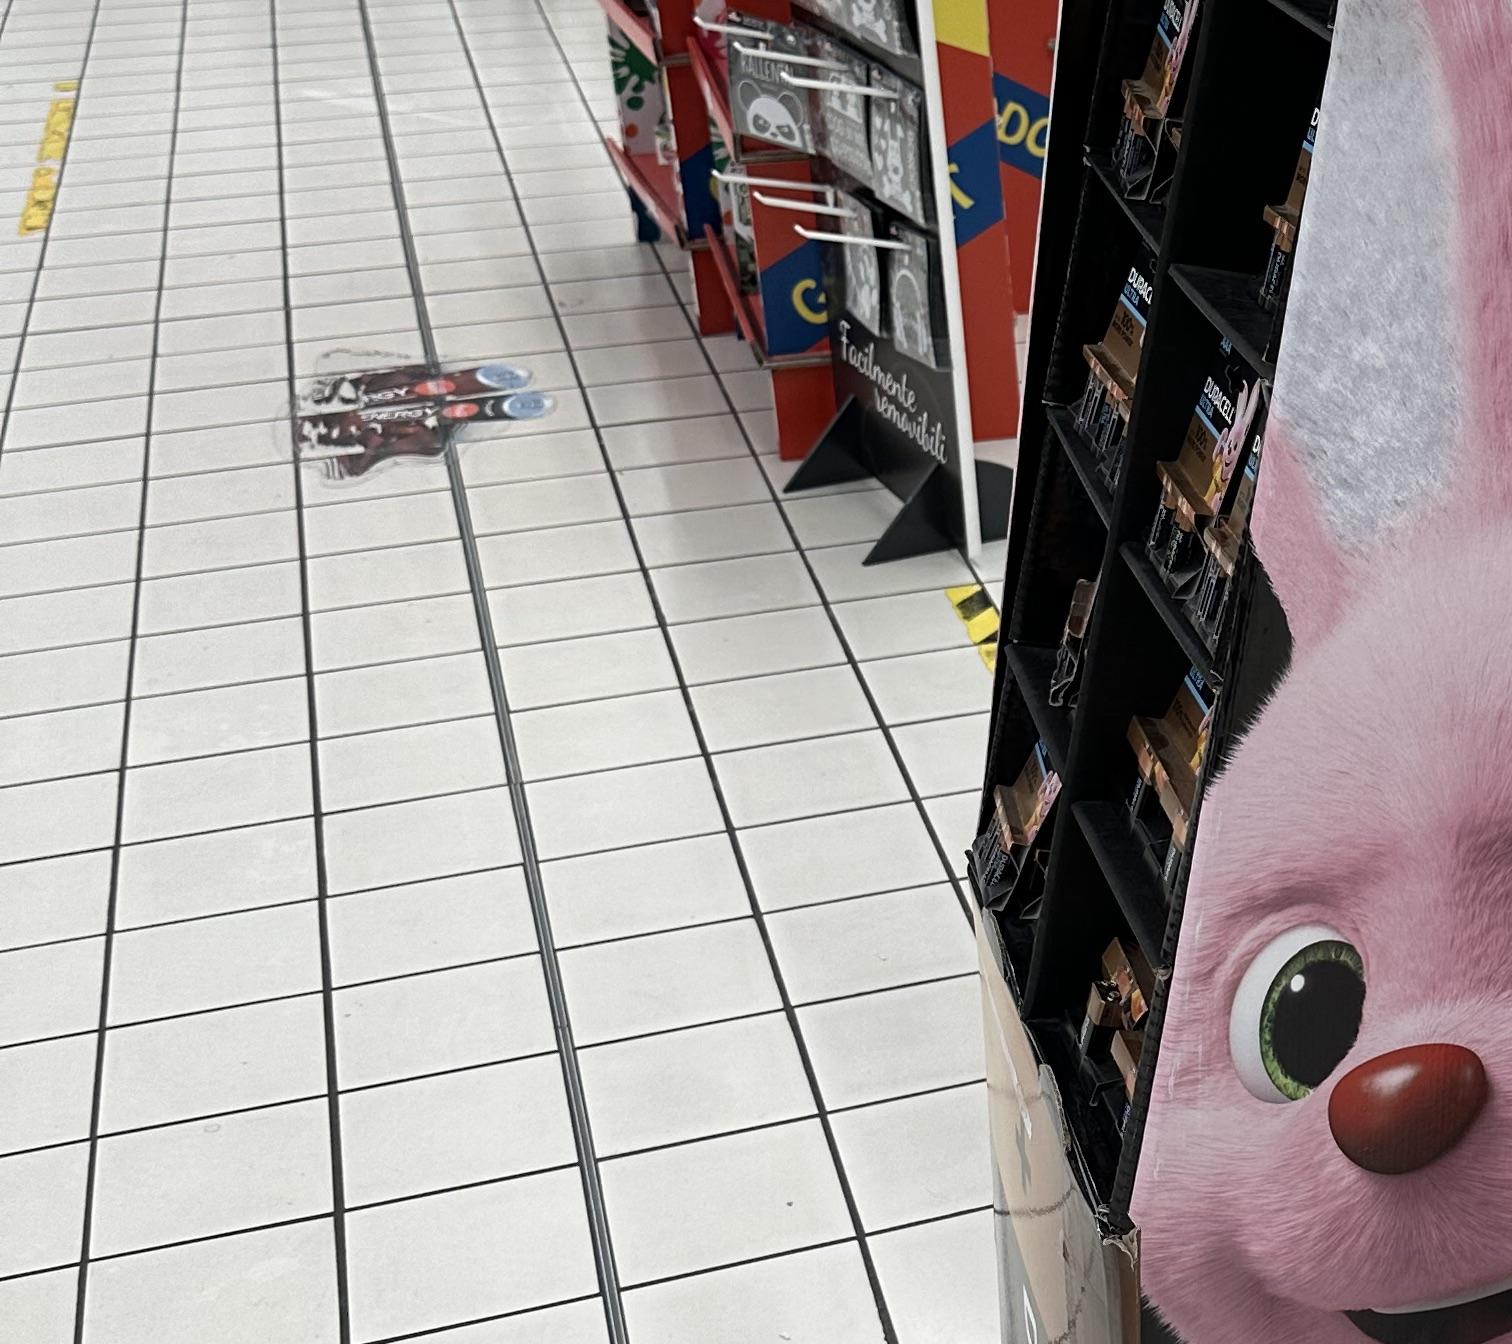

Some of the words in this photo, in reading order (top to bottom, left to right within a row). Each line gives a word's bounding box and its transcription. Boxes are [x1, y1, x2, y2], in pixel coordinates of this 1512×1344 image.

[839, 320, 917, 413] Facilmente
[1204, 376, 1235, 425] DURACELL
[874, 388, 948, 464] removibili
